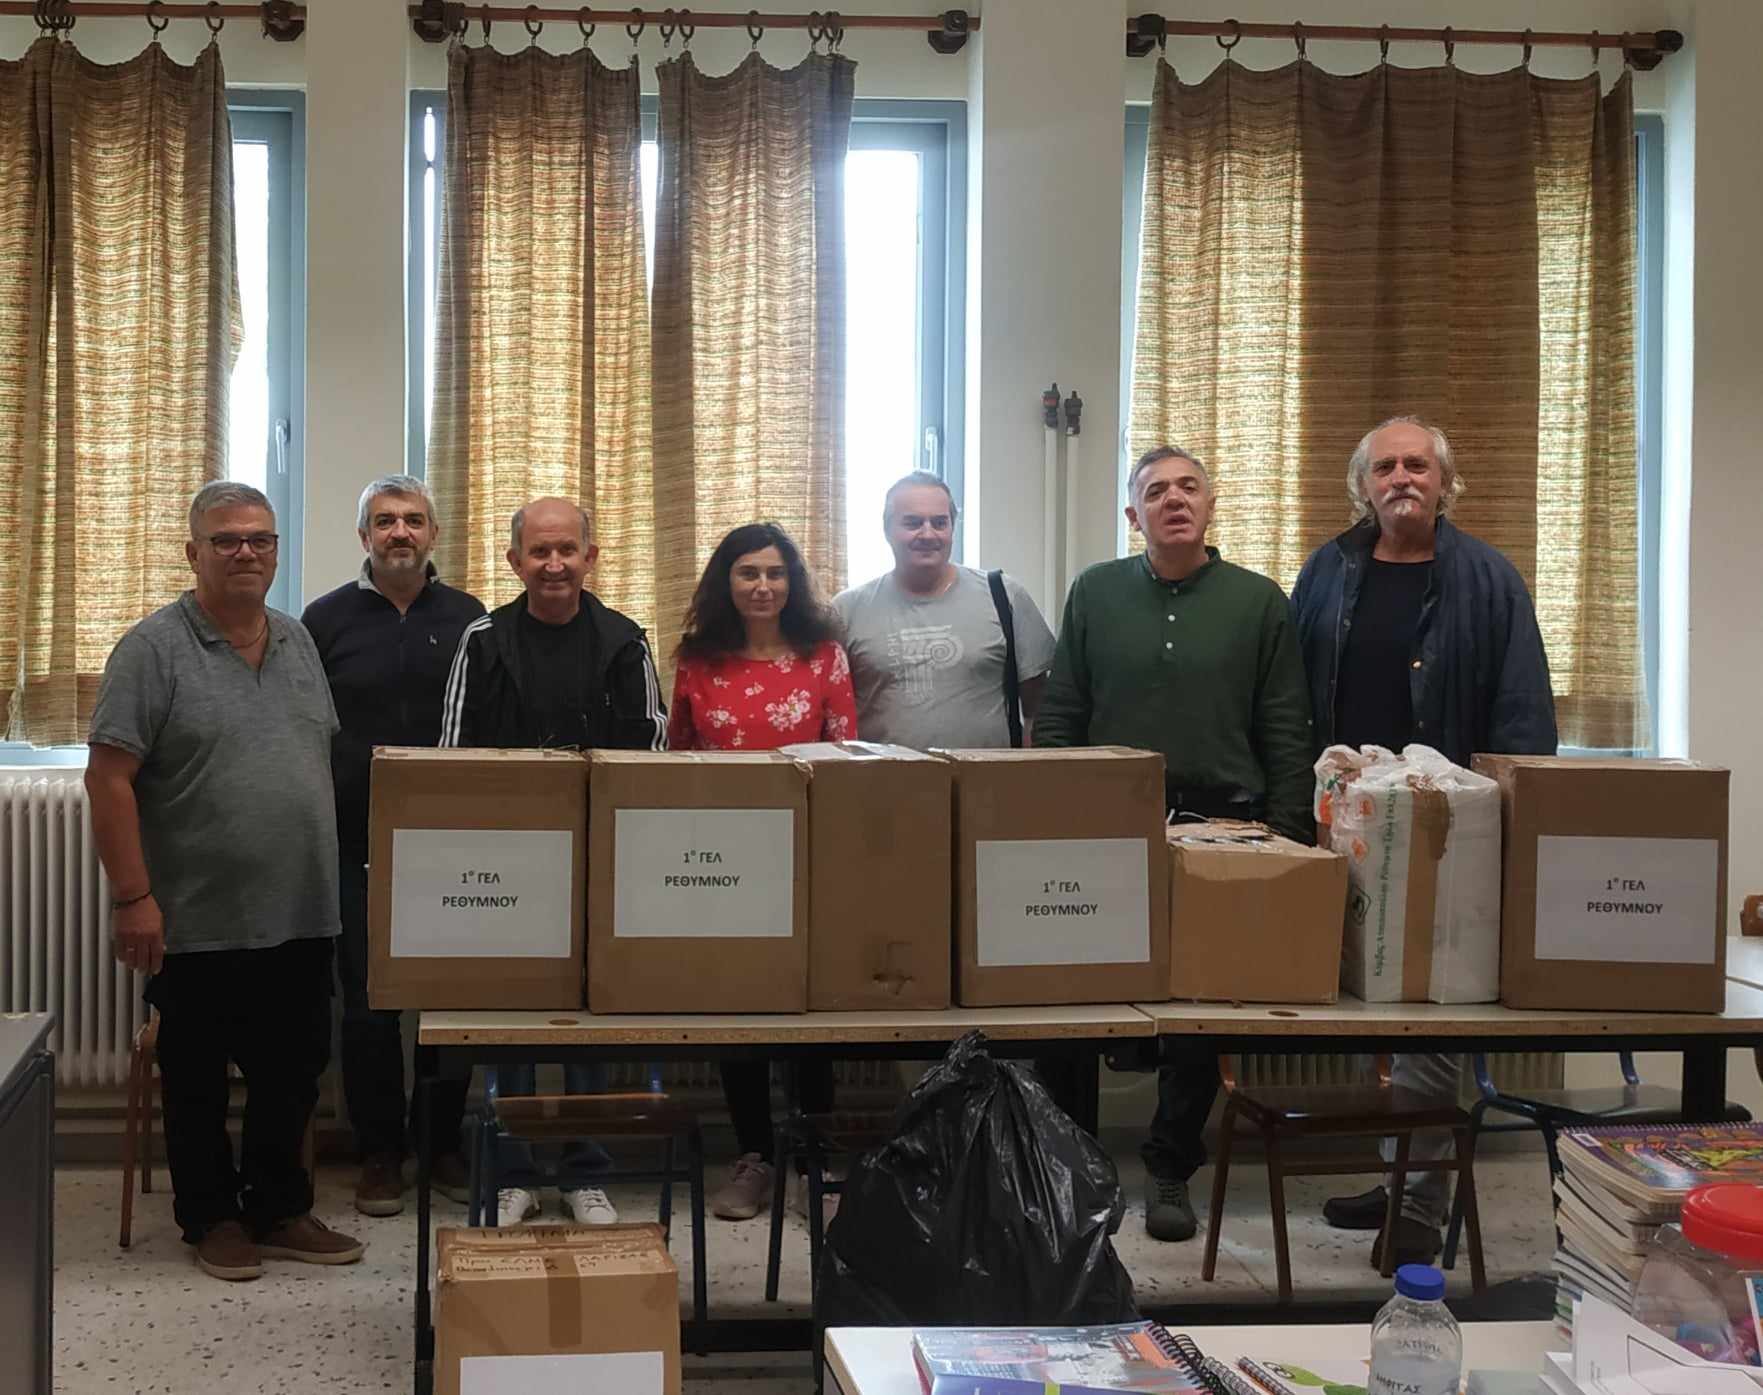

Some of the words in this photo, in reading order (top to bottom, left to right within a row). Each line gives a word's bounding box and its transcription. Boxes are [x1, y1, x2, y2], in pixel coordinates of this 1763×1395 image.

[699, 852, 723, 864] ΓΕΛ
[478, 873, 500, 884] ΓΕΛ
[664, 875, 740, 888] ΡΕΘΥΜΝΟΥ
[1058, 882, 1081, 893] ΓΕΛ
[1622, 880, 1645, 891] ΓΕΛ
[442, 895, 519, 908] ΡΕΘΥΜΝΟΥ
[1025, 903, 1098, 917] ΡΕΘΥΜΝΟΥ
[1586, 902, 1663, 914] ΡΕΘΥΜΝΟΥ
